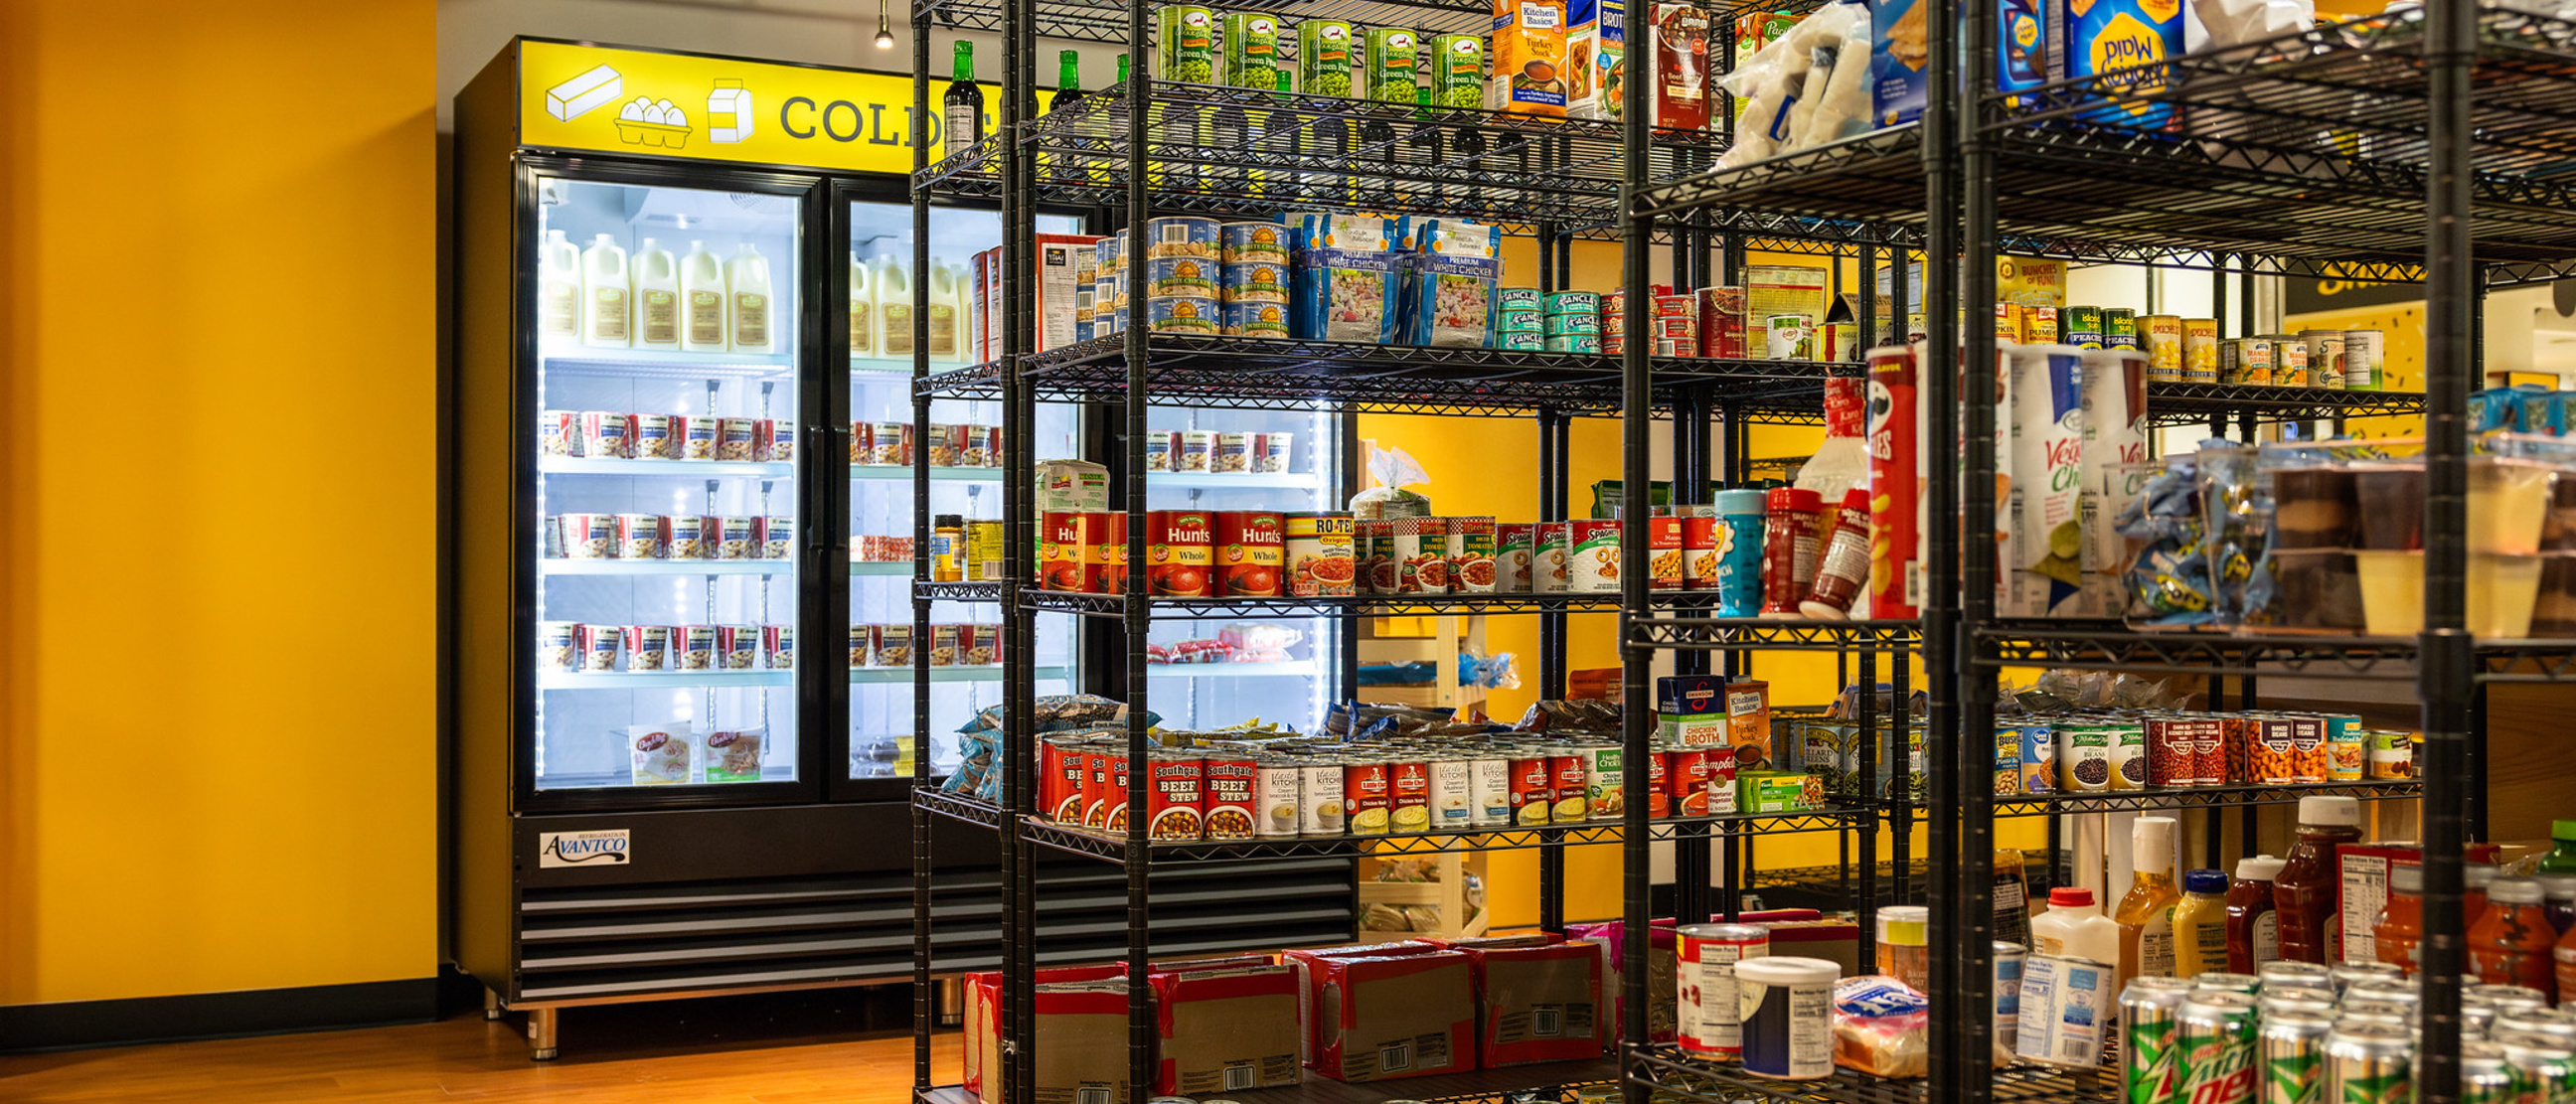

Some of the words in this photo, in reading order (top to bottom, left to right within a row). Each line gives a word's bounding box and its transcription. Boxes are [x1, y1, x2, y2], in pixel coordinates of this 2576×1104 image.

[1523, 7, 1555, 17] Kitchen
[1527, 16, 1553, 25] Basics
[1602, 11, 1624, 29] BROT
[1525, 38, 1552, 51] Turkey
[2104, 35, 2152, 65] Maid
[1530, 48, 1550, 57] Stock
[1312, 62, 1337, 71] Green
[1378, 70, 1403, 79] Green
[780, 95, 942, 148] COLD
[1327, 257, 1351, 268] WHITE
[1352, 259, 1387, 270] CHICKEN
[1449, 256, 1480, 265] PREMIUM
[1433, 263, 1457, 274] WHITE
[1459, 265, 1493, 276] CHICKEN
[2021, 263, 2057, 276] BUNCHES
[2072, 333, 2102, 343] PEACH
[1830, 397, 1850, 408] Karo
[1841, 409, 1860, 422] Karo
[1179, 551, 1206, 560] Whole
[1253, 552, 1278, 561] Whole
[1730, 695, 1759, 707] Kitchen
[1734, 704, 1758, 712] Basics
[1687, 726, 1717, 735] CHICKEN
[1734, 724, 1758, 735] Turkey
[1685, 733, 1720, 745] BROTH
[1155, 764, 1201, 777] Southgate
[1208, 764, 1253, 777] Southgate
[1160, 781, 1197, 792] BEEF
[1210, 779, 1246, 791] BEEF
[1170, 792, 1200, 802] STEW
[1219, 791, 1250, 802] STEW
[543, 835, 627, 857] AVANTCO
